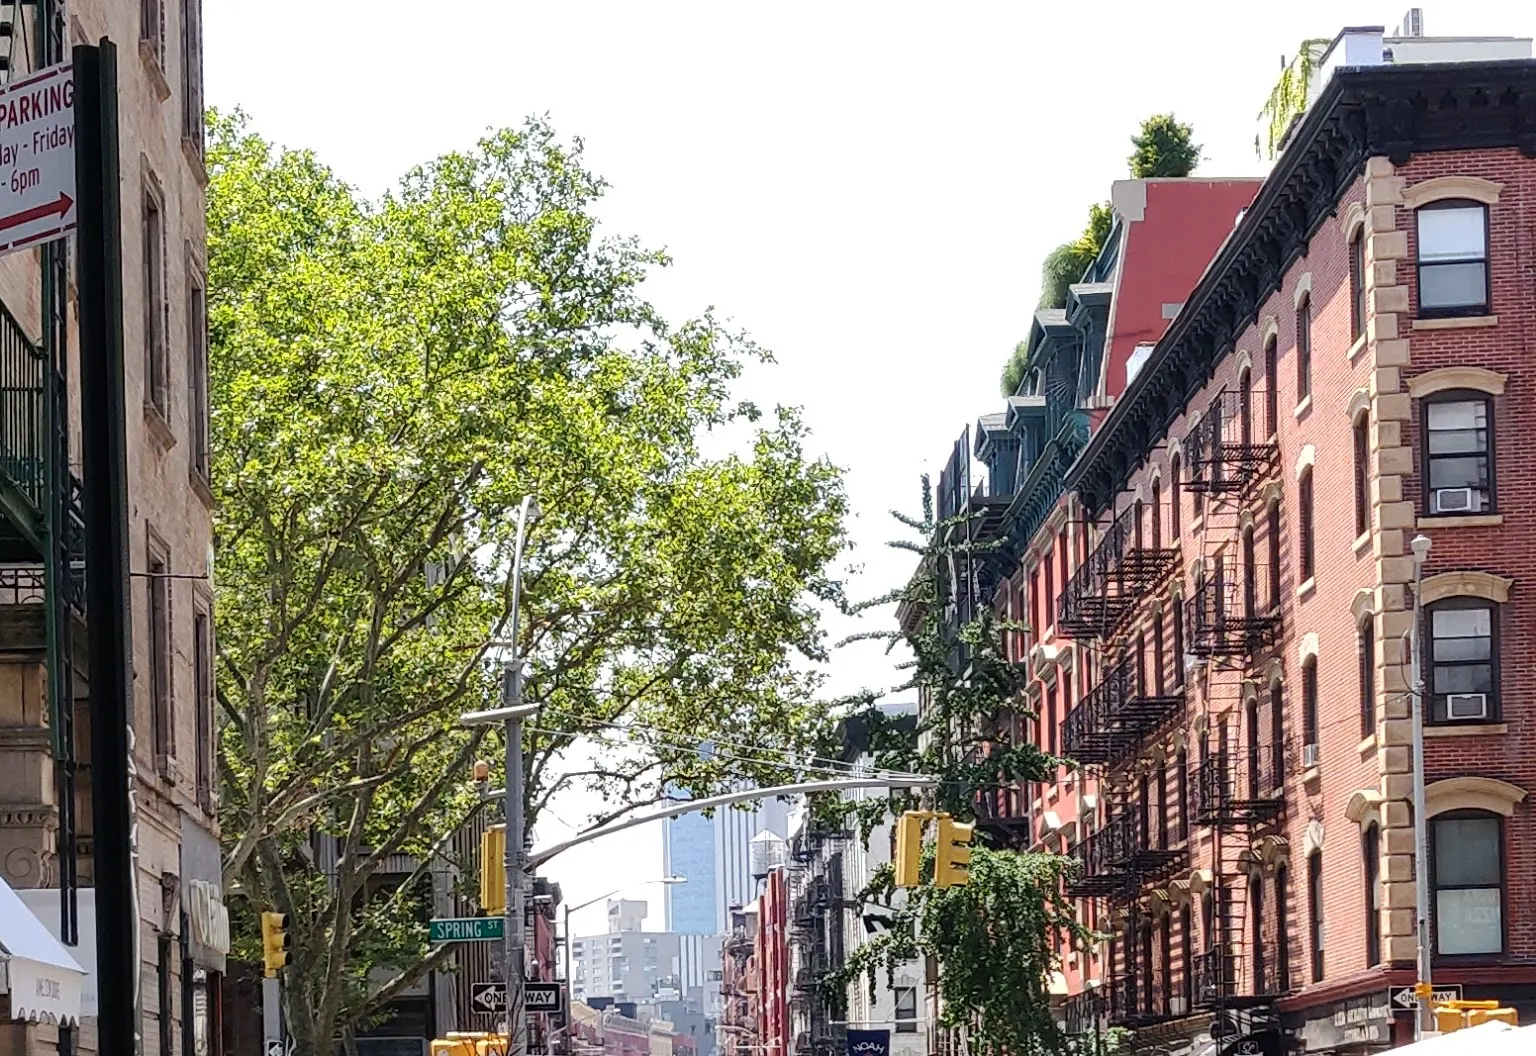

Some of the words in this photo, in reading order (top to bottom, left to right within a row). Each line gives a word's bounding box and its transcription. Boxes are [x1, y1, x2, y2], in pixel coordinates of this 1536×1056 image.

[33, 124, 75, 155] Friday
[11, 167, 40, 195] 6pm
[437, 922, 482, 938] SPRING
[487, 921, 499, 930] ST
[525, 991, 552, 1004] WAY
[1431, 992, 1452, 1001] WAY
[852, 1041, 885, 1055] NOAH
